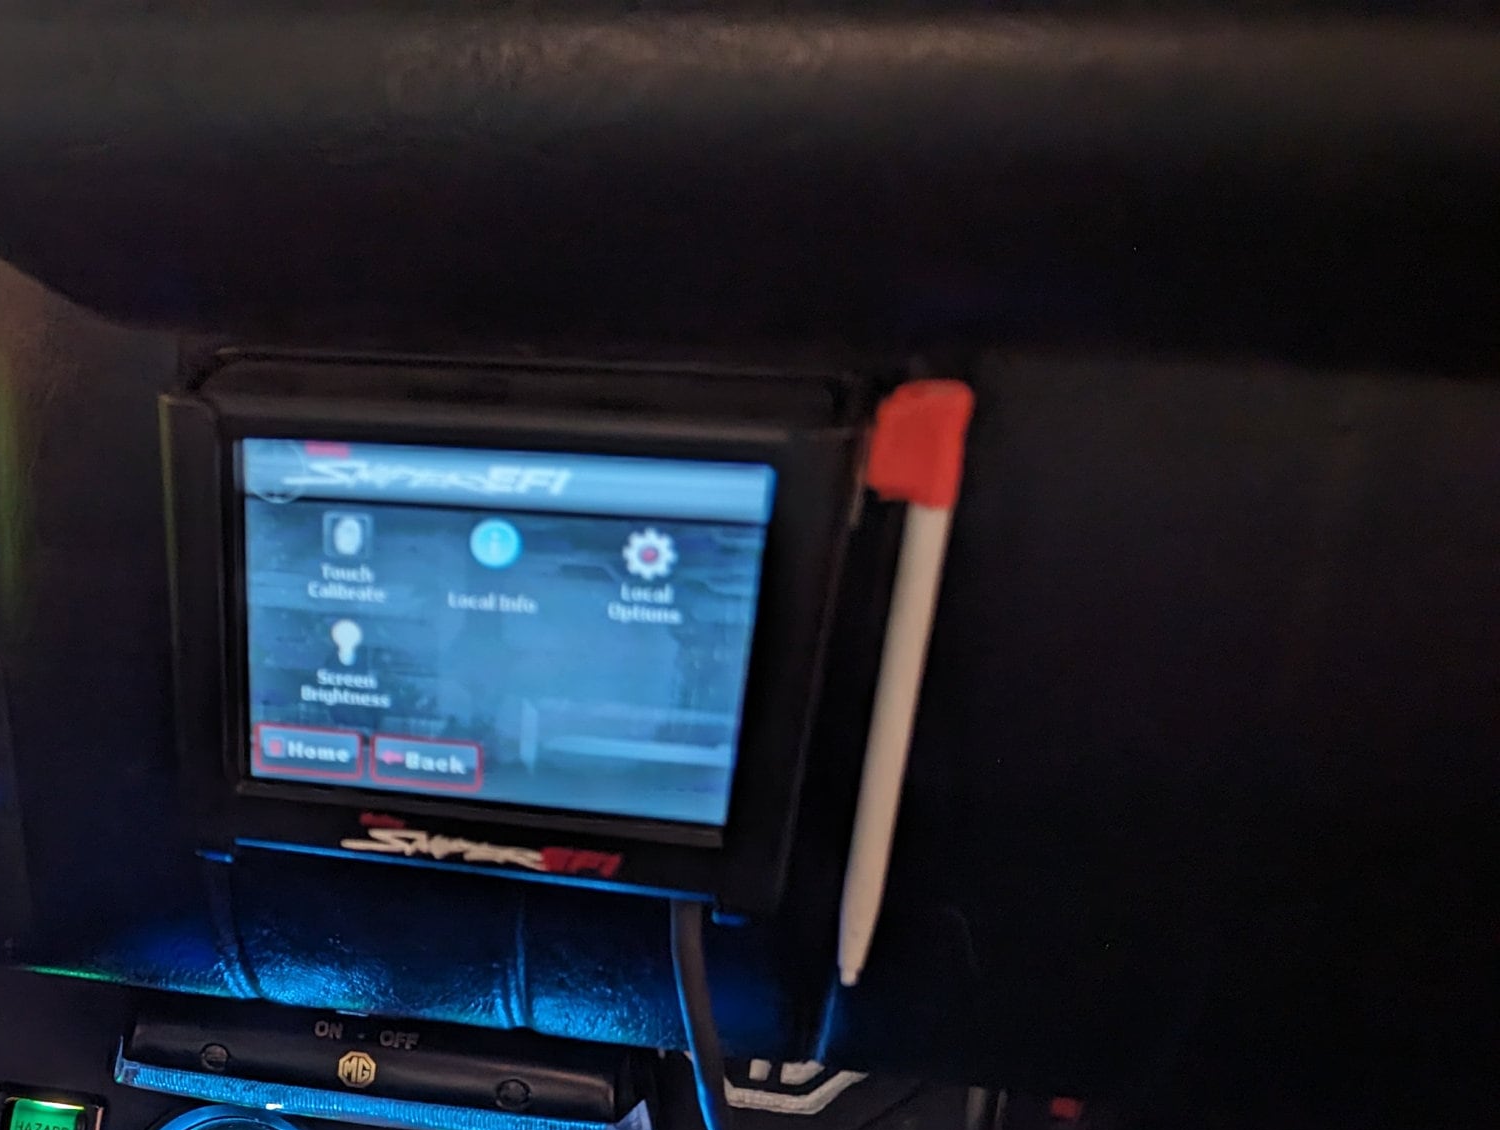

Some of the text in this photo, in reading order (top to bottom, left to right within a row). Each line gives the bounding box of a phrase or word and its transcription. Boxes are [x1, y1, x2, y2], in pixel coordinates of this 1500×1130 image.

[320, 563, 375, 583] Touch
[621, 582, 674, 605] Local
[316, 668, 378, 690] Screen
[301, 684, 392, 709] Brightness
[287, 740, 350, 763] Home
[405, 751, 467, 775] Back
[314, 1020, 420, 1050] ON OFF
[341, 1055, 372, 1084] MG
